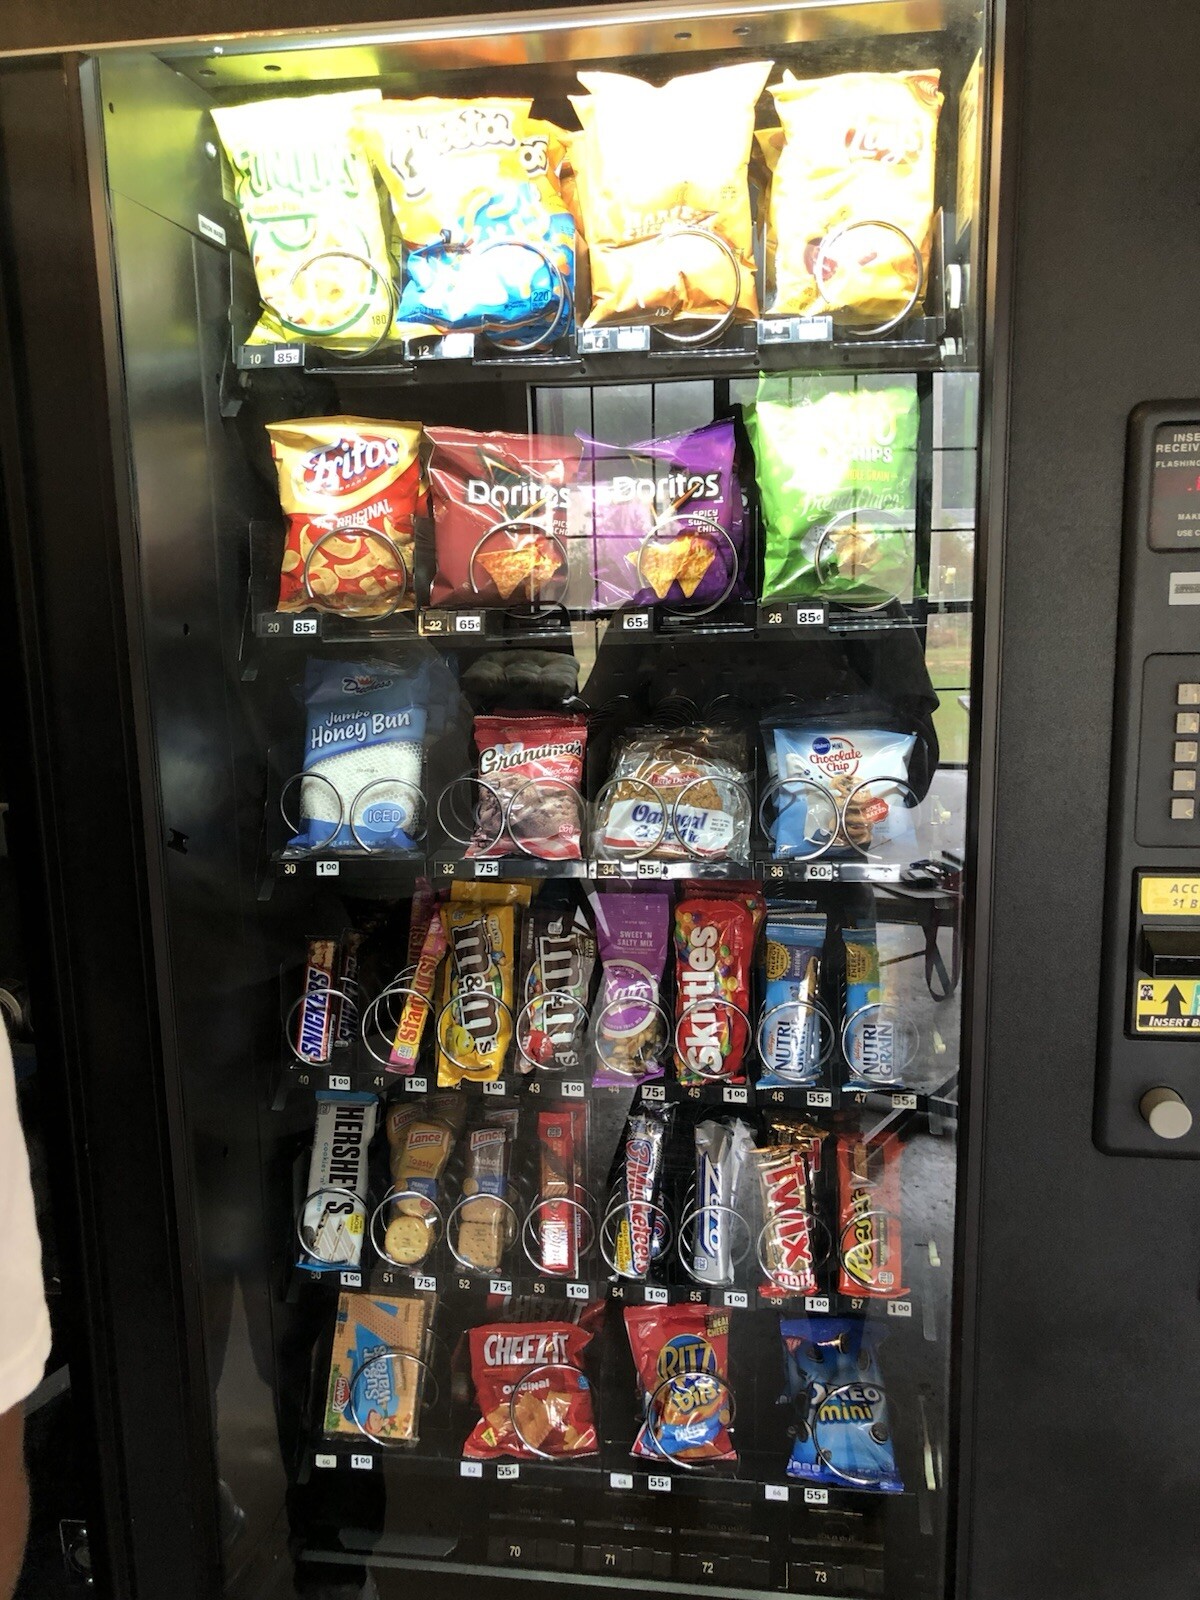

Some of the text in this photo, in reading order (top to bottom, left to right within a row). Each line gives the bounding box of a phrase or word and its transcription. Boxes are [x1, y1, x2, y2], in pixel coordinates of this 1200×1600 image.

[534, 291, 549, 302] 220
[371, 314, 387, 327] 180
[417, 345, 431, 356] 12
[249, 351, 298, 366] 10 85¢
[302, 437, 399, 484] Fritos
[468, 479, 571, 509] Doritos
[612, 473, 718, 504] Doritos
[1176, 529, 1194, 537] USE
[459, 617, 480, 629] 65¢
[627, 616, 649, 629] 65¢
[768, 612, 822, 625] 26 85¢
[268, 621, 316, 633] 20 85¢
[326, 710, 371, 727] Jumbo
[312, 711, 411, 749] Honey Bun
[809, 750, 863, 767] Chocolate
[826, 761, 850, 775] Chip
[368, 810, 402, 823] ICED
[631, 804, 709, 830] Oameal
[284, 864, 296, 874] 30
[442, 862, 499, 874] 32 75¢
[638, 865, 660, 875] 55¢
[770, 866, 832, 877] 36 60¢
[620, 931, 643, 939] SWEET
[617, 939, 654, 948] SALTY MIX
[682, 925, 724, 1075] Skittles
[300, 968, 332, 1060] SNICKERS
[1148, 1016, 1190, 1027] INSERT
[774, 1020, 790, 1072] NUTRI
[863, 1023, 876, 1076] NUTRI
[878, 1022, 893, 1077] GRAIN
[298, 1075, 309, 1085] 40
[373, 1076, 385, 1086] 41
[528, 1082, 541, 1093] 43
[644, 1086, 664, 1097] 75¢
[688, 1087, 701, 1098] 45
[771, 1092, 829, 1104] 46 55¢
[854, 1094, 914, 1106] 47 55¢
[408, 1132, 442, 1146] Lance
[472, 1129, 503, 1146] Lance
[626, 1138, 656, 1167] 3
[409, 1155, 434, 1169] Toasty
[762, 1152, 812, 1267] TWIX
[382, 1272, 435, 1288] 51 75¢
[459, 1278, 512, 1291] 52 75¢
[533, 1283, 546, 1294] 53
[612, 1287, 624, 1298] 54
[689, 1291, 702, 1302] 55
[851, 1298, 864, 1310] 57
[659, 1342, 714, 1380] RITZ
[364, 1346, 380, 1402] Sugr
[818, 1402, 874, 1421] mini
[497, 1467, 518, 1477] 55¢
[649, 1477, 670, 1487] 55¢
[806, 1489, 827, 1499] 55¢
[509, 1545, 522, 1557] 70
[604, 1553, 617, 1566] 71
[701, 1561, 714, 1574] 72
[814, 1570, 828, 1583] 73
